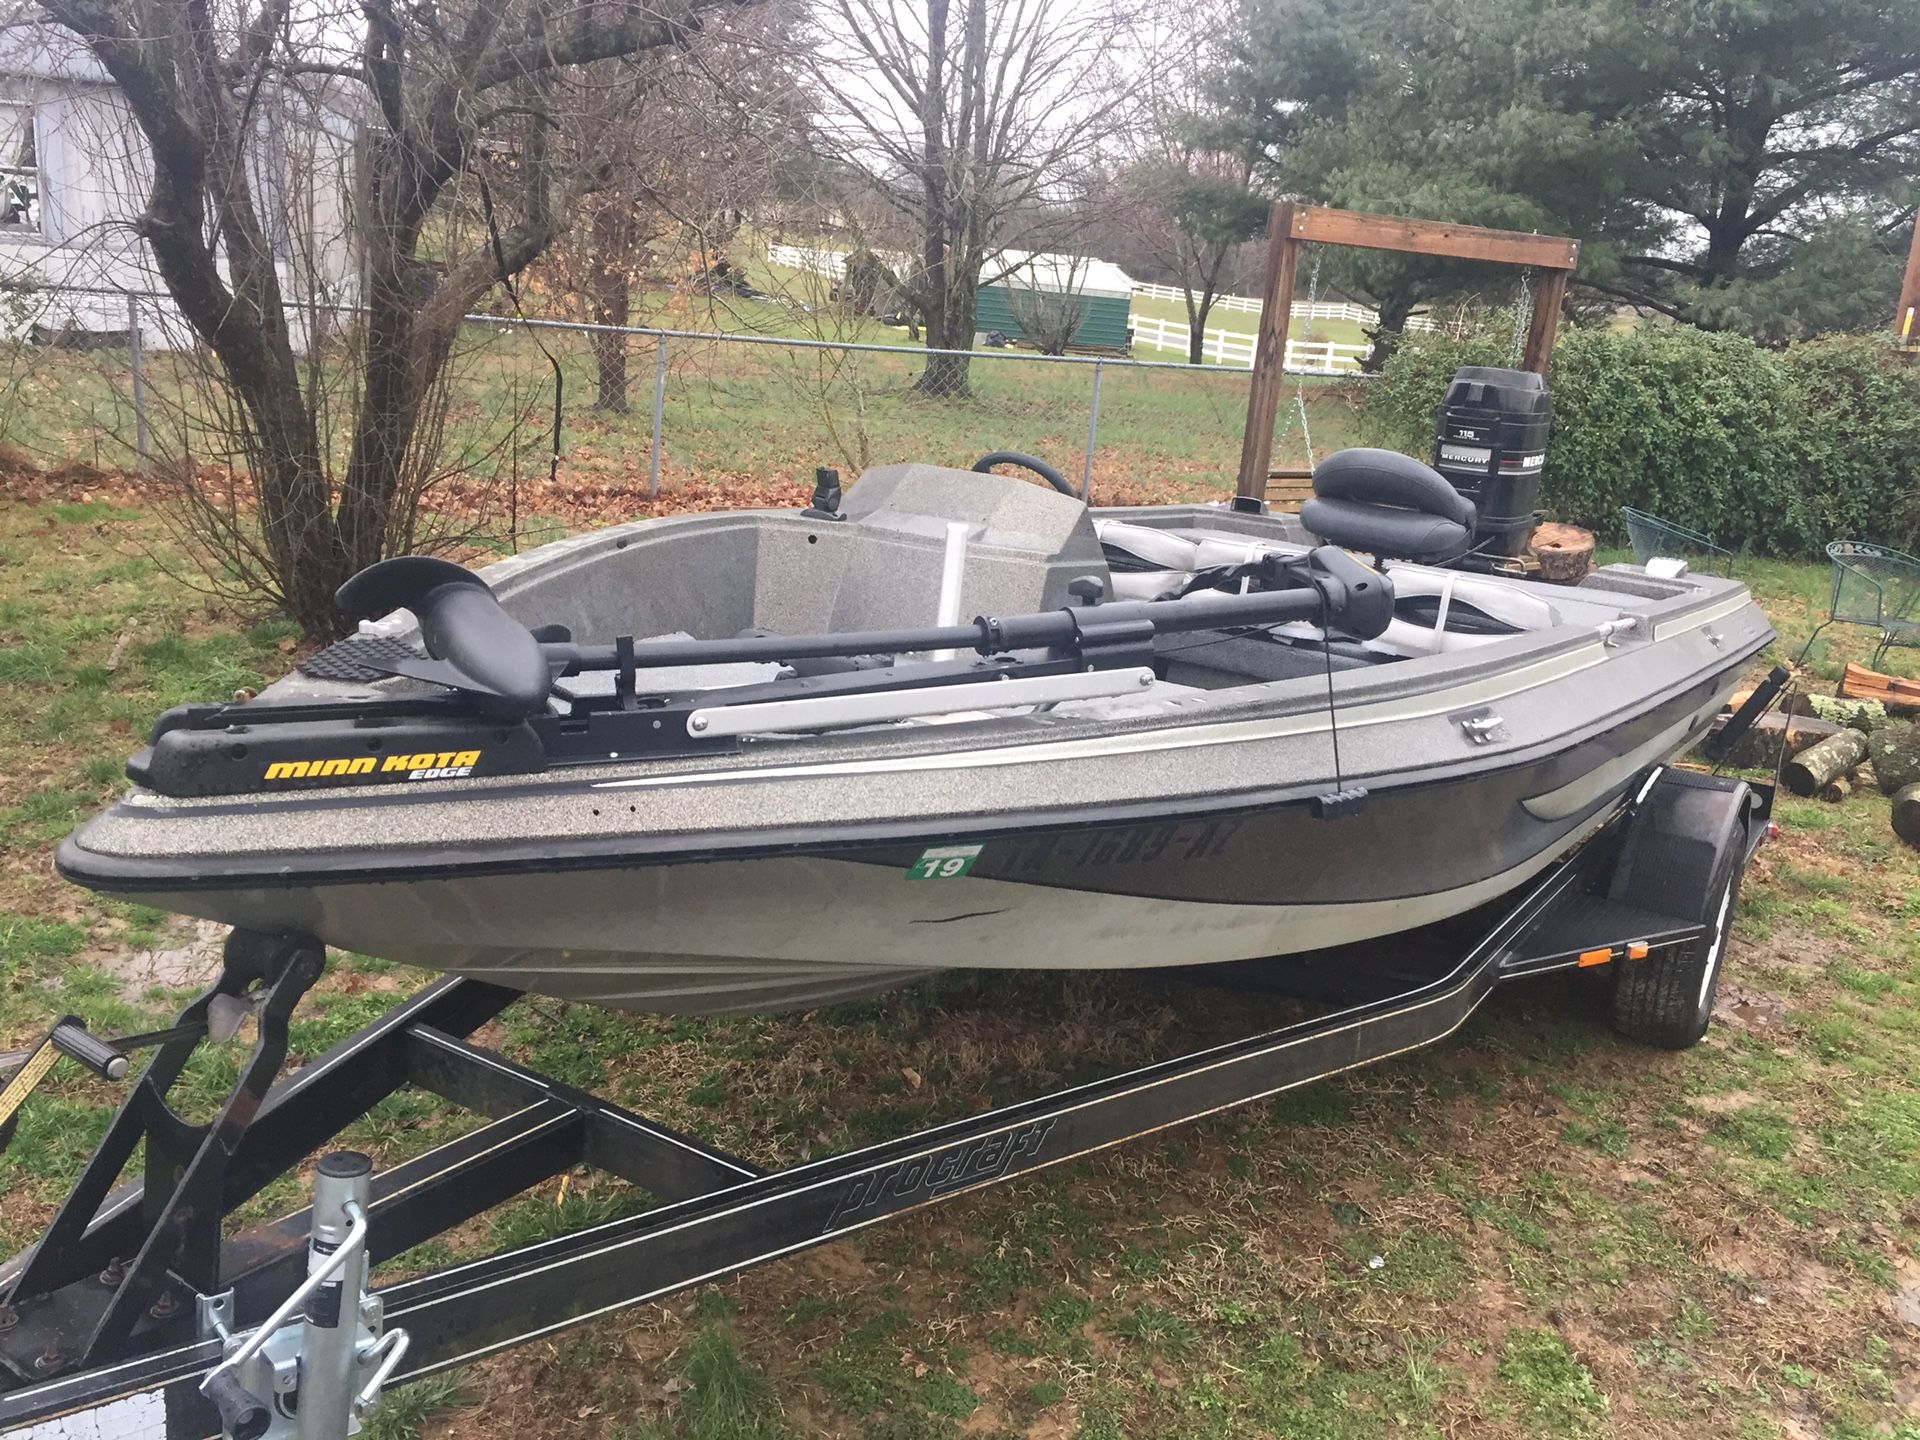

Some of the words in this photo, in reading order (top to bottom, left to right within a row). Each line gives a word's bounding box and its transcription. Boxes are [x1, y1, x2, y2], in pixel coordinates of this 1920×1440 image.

[1459, 429, 1475, 438] 115
[1441, 453, 1489, 464] MERCURY
[263, 757, 377, 780] MINN
[381, 750, 481, 772] KOTA
[408, 766, 473, 780] EDGE
[923, 858, 965, 878] 19
